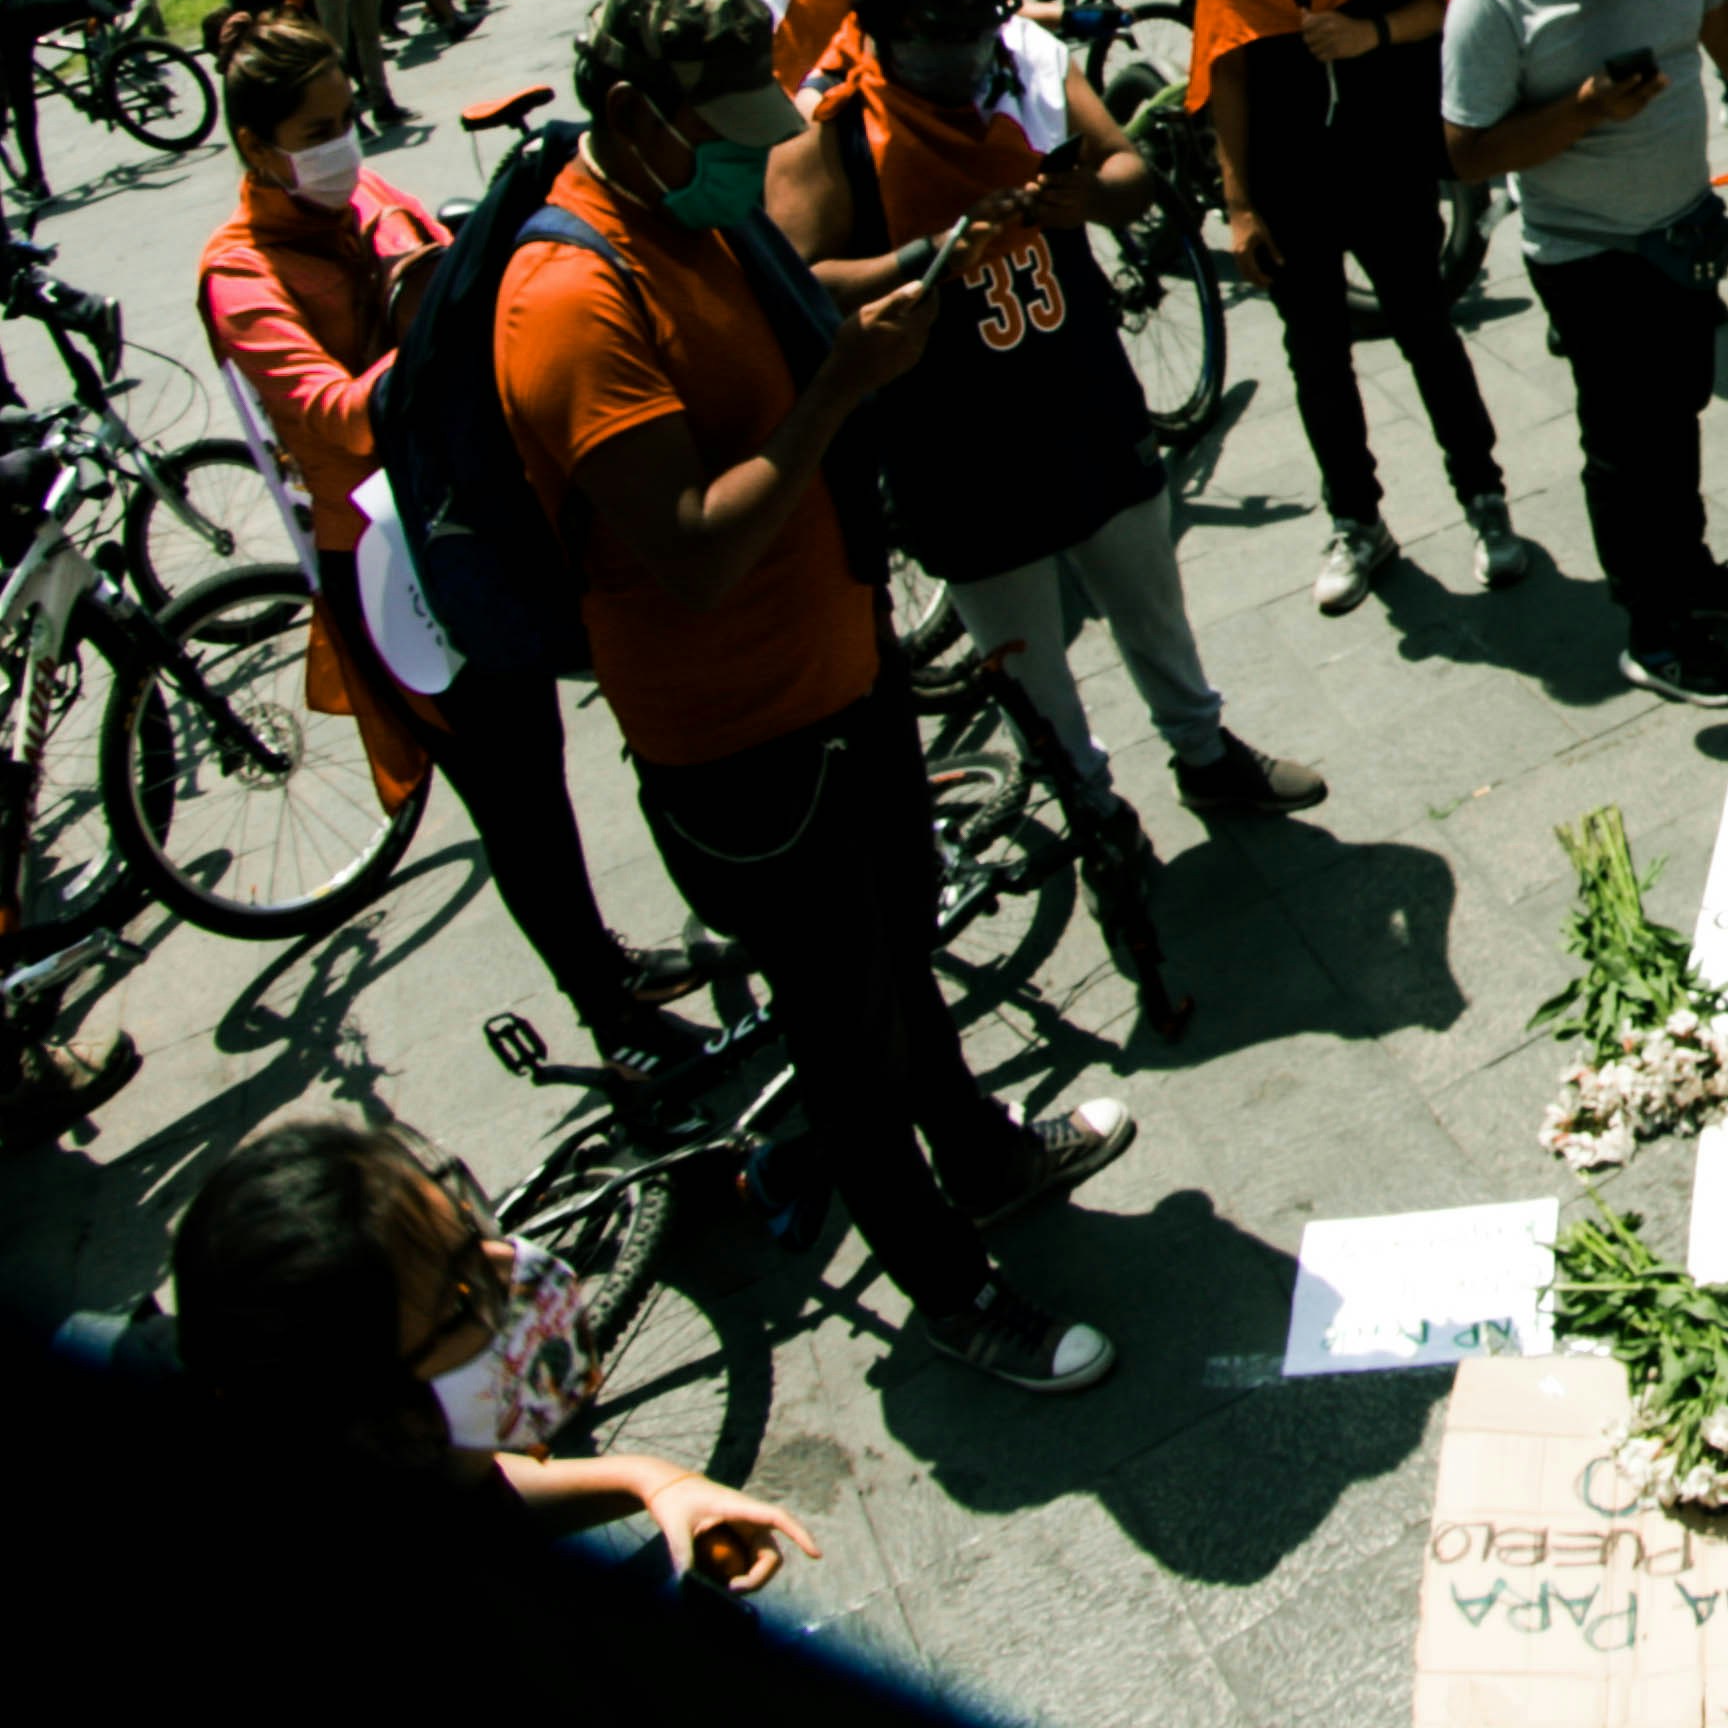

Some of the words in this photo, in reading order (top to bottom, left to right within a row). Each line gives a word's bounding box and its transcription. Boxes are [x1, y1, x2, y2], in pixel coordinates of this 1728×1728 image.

[964, 231, 1067, 353] 33
[1430, 1521, 1692, 1578] PUEBLO
[1451, 1577, 1638, 1653] PARA
